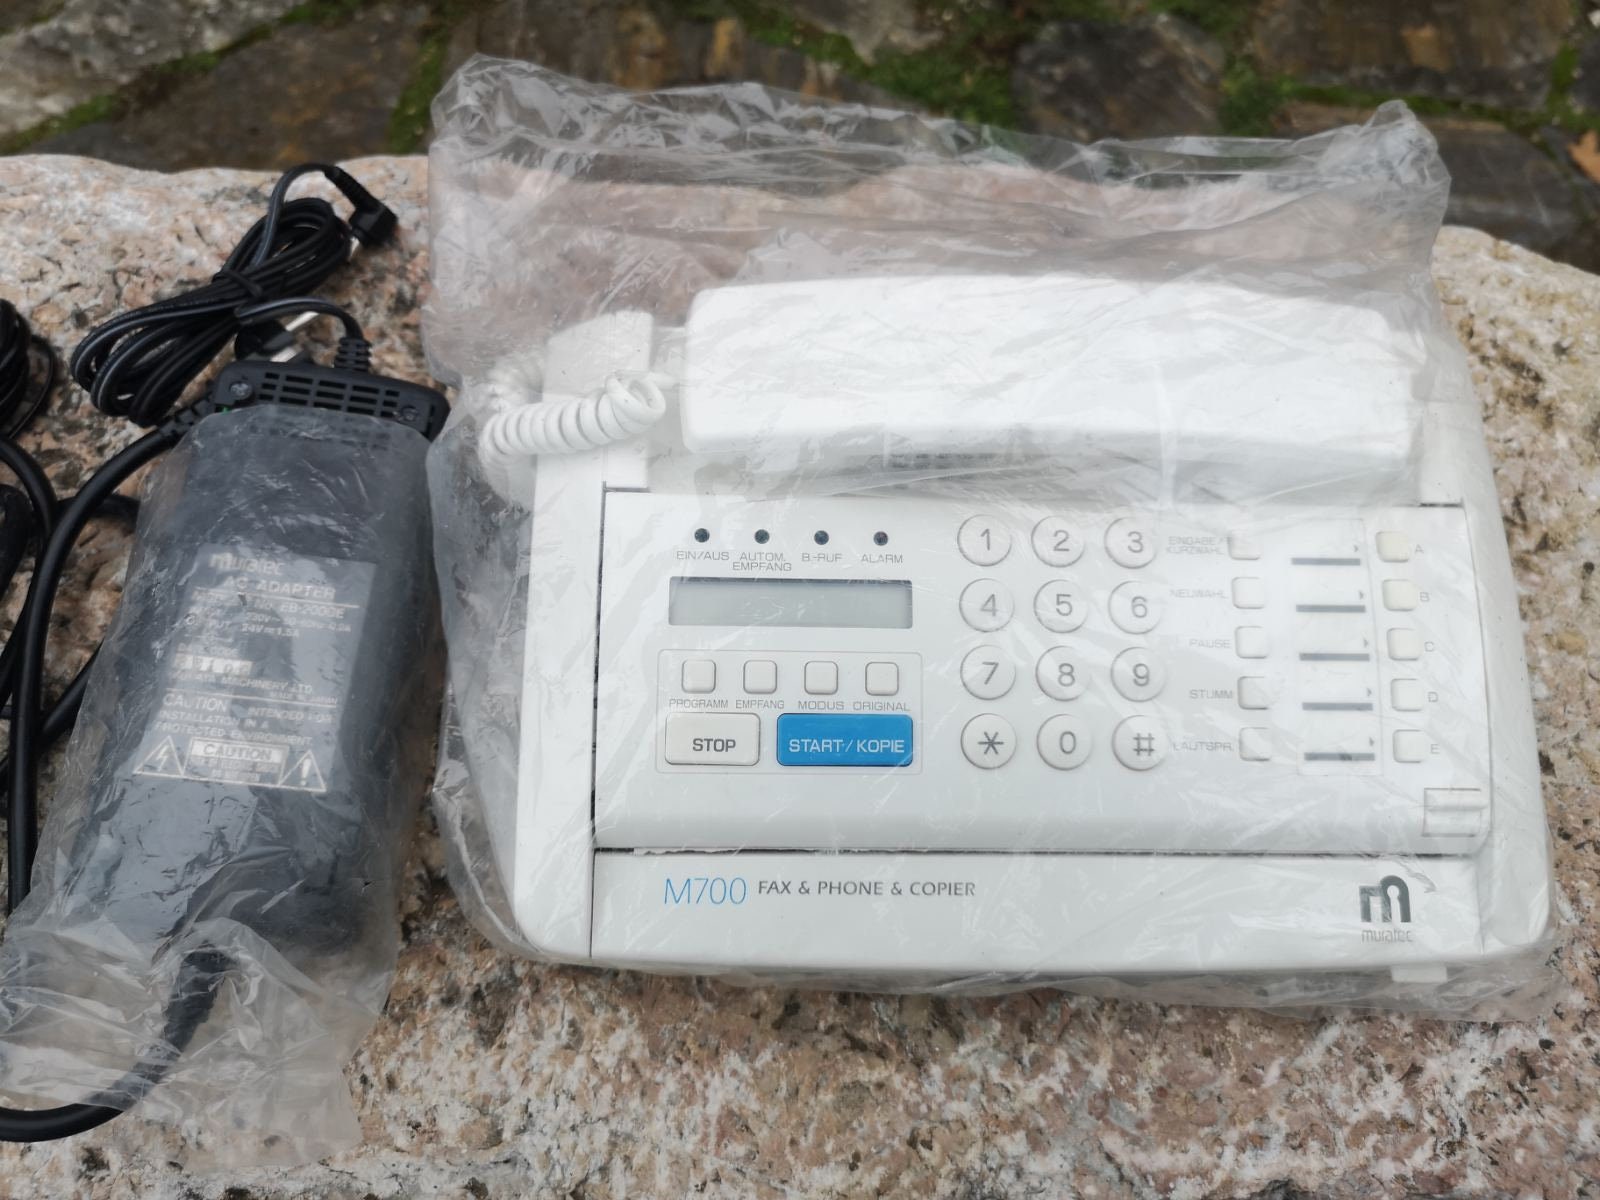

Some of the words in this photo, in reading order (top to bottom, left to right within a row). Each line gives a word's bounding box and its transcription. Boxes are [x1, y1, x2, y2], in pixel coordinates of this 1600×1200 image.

[980, 529, 990, 550] 1
[1053, 530, 1070, 551] 2
[1127, 531, 1144, 553] 3
[1414, 544, 1424, 553] A
[676, 551, 730, 561] EIN/AUS
[739, 552, 786, 562] AUTOM.
[861, 554, 904, 564] ALARM
[732, 562, 792, 572] EMPFANG
[256, 579, 336, 599] ADAPTER
[1420, 592, 1430, 602] B
[980, 593, 997, 617] 4
[1056, 594, 1073, 616] 5
[1131, 596, 1148, 618] 6
[1189, 639, 1232, 648] PAUSE
[1424, 641, 1434, 652] C
[982, 662, 999, 685] 7
[1058, 663, 1075, 687] 8
[1132, 663, 1150, 687] 9
[1189, 690, 1233, 699] STUMM
[1428, 691, 1439, 702] D
[163, 693, 228, 713] CAUTION
[669, 699, 728, 709] PROGRAMM
[735, 700, 785, 709] EMPFANG
[798, 701, 845, 711] MODUS
[852, 701, 911, 712] ORIGINAL
[692, 738, 736, 752] STOP
[1133, 733, 1155, 756] #
[1430, 743, 1440, 755] E
[203, 743, 272, 761] CAUTION
[664, 877, 747, 904] M700
[758, 880, 792, 895] FAX
[798, 880, 810, 895] &
[817, 880, 883, 896] PHONE
[890, 881, 903, 896] &
[910, 881, 976, 897] COPIER
